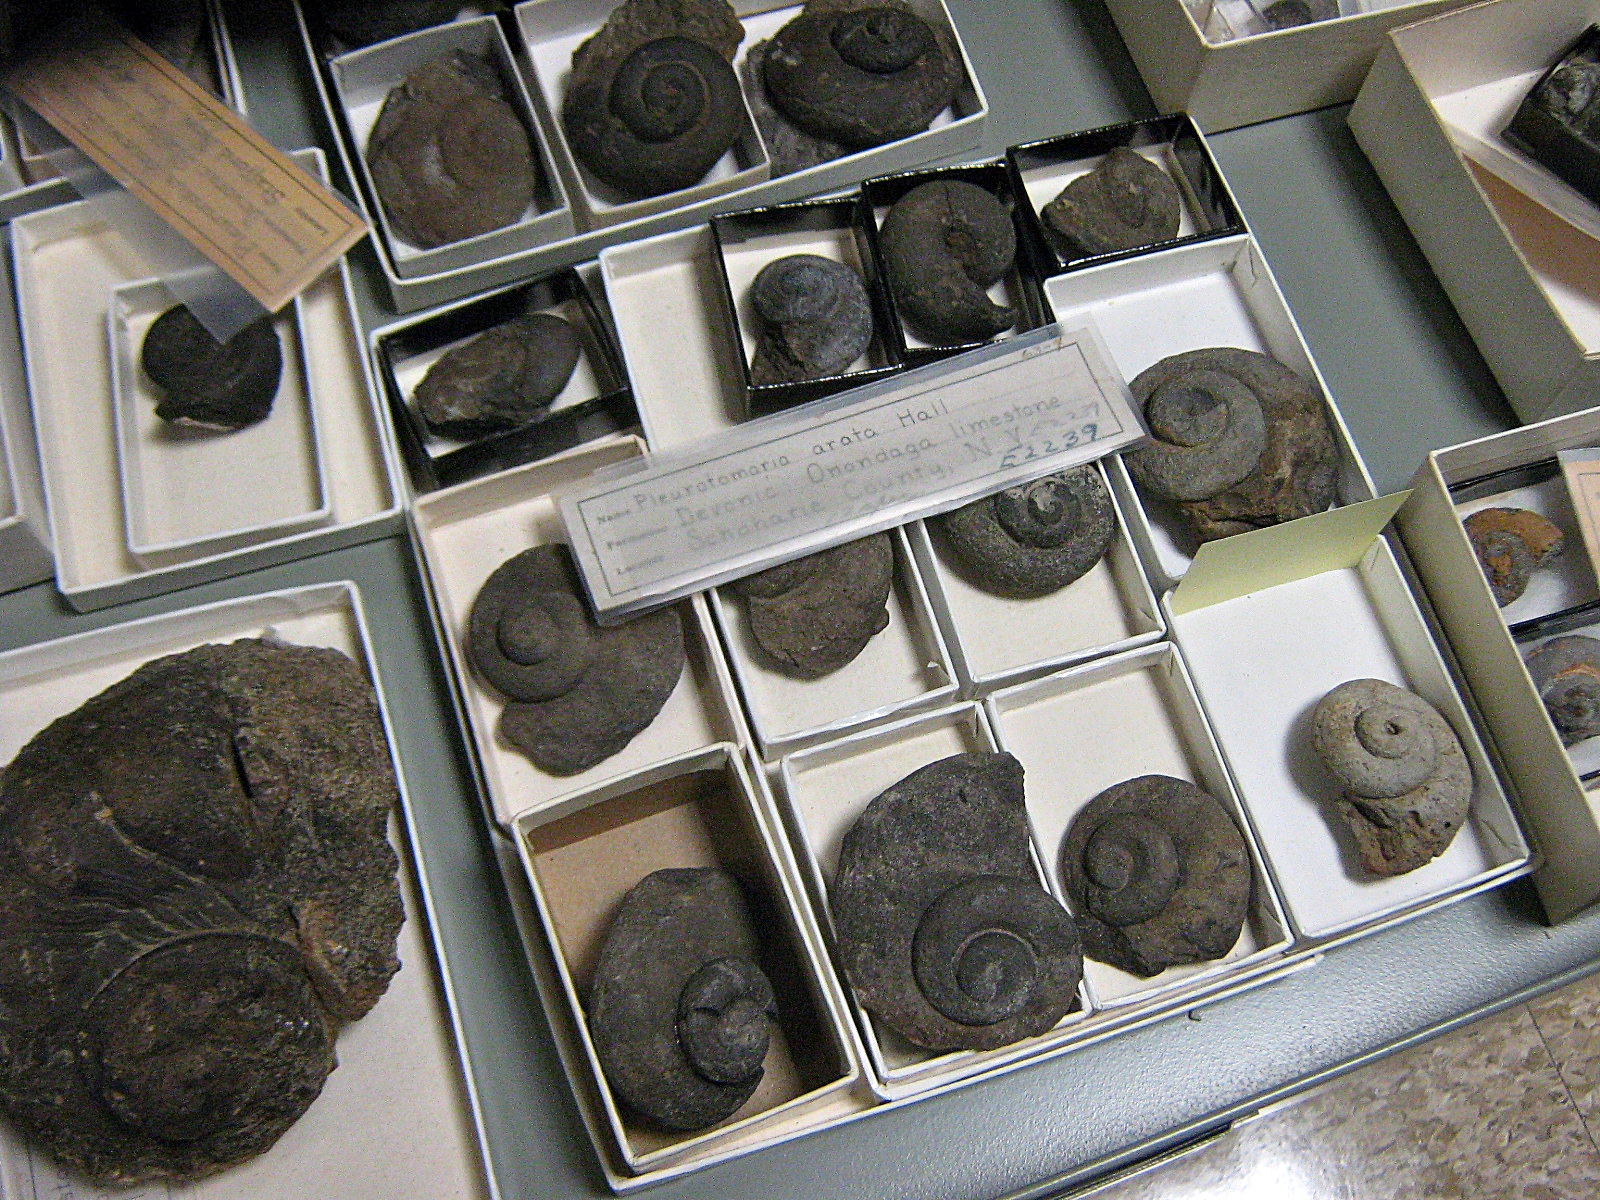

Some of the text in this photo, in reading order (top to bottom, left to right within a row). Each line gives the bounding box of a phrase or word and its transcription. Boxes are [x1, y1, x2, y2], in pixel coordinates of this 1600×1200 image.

[634, 454, 790, 507] Pleurotomaria
[813, 426, 878, 456] arata
[896, 398, 948, 427] Hall
[805, 437, 937, 483] Onondaga
[949, 396, 1061, 439] limestone
